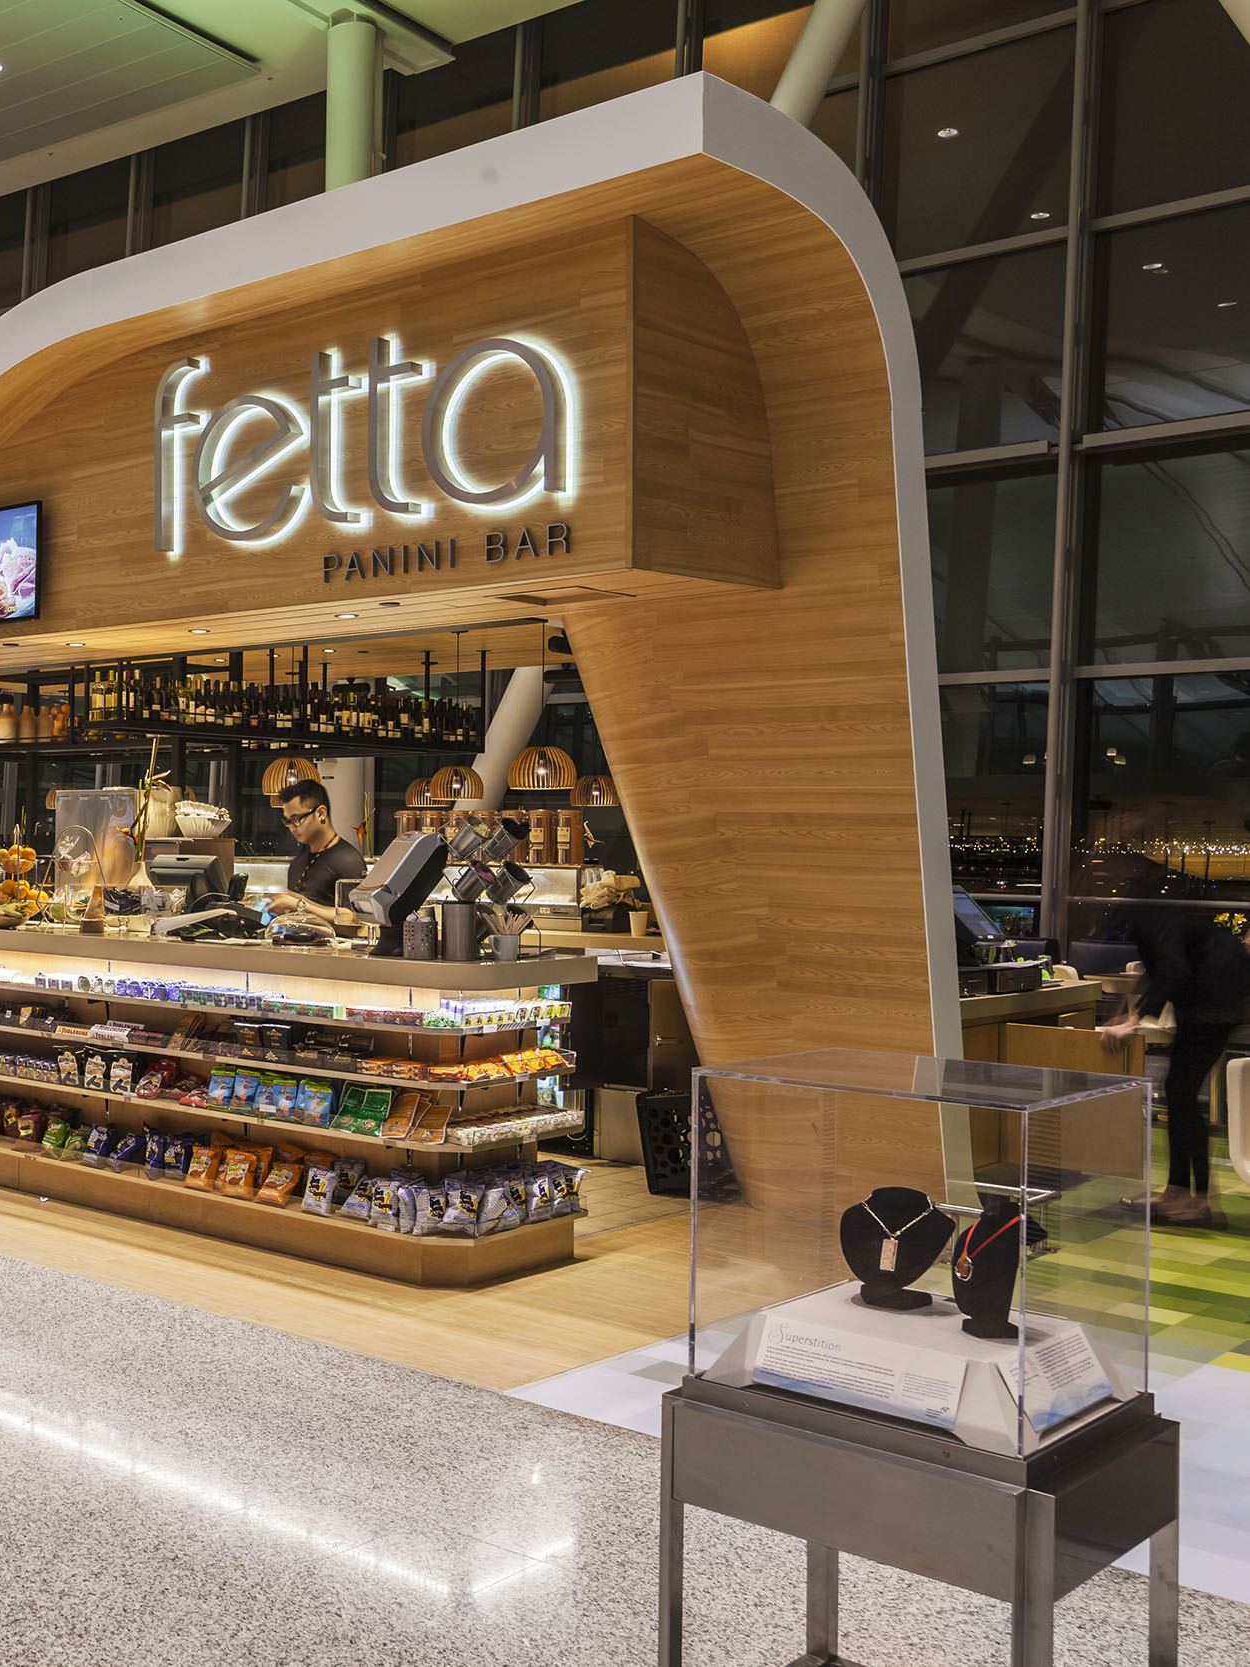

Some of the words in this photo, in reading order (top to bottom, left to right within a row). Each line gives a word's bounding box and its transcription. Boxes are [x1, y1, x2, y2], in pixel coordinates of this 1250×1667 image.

[154, 336, 572, 554] fetta
[321, 538, 457, 583] PANINI
[483, 522, 572, 564] BAR
[768, 1323, 841, 1352] Superstition
